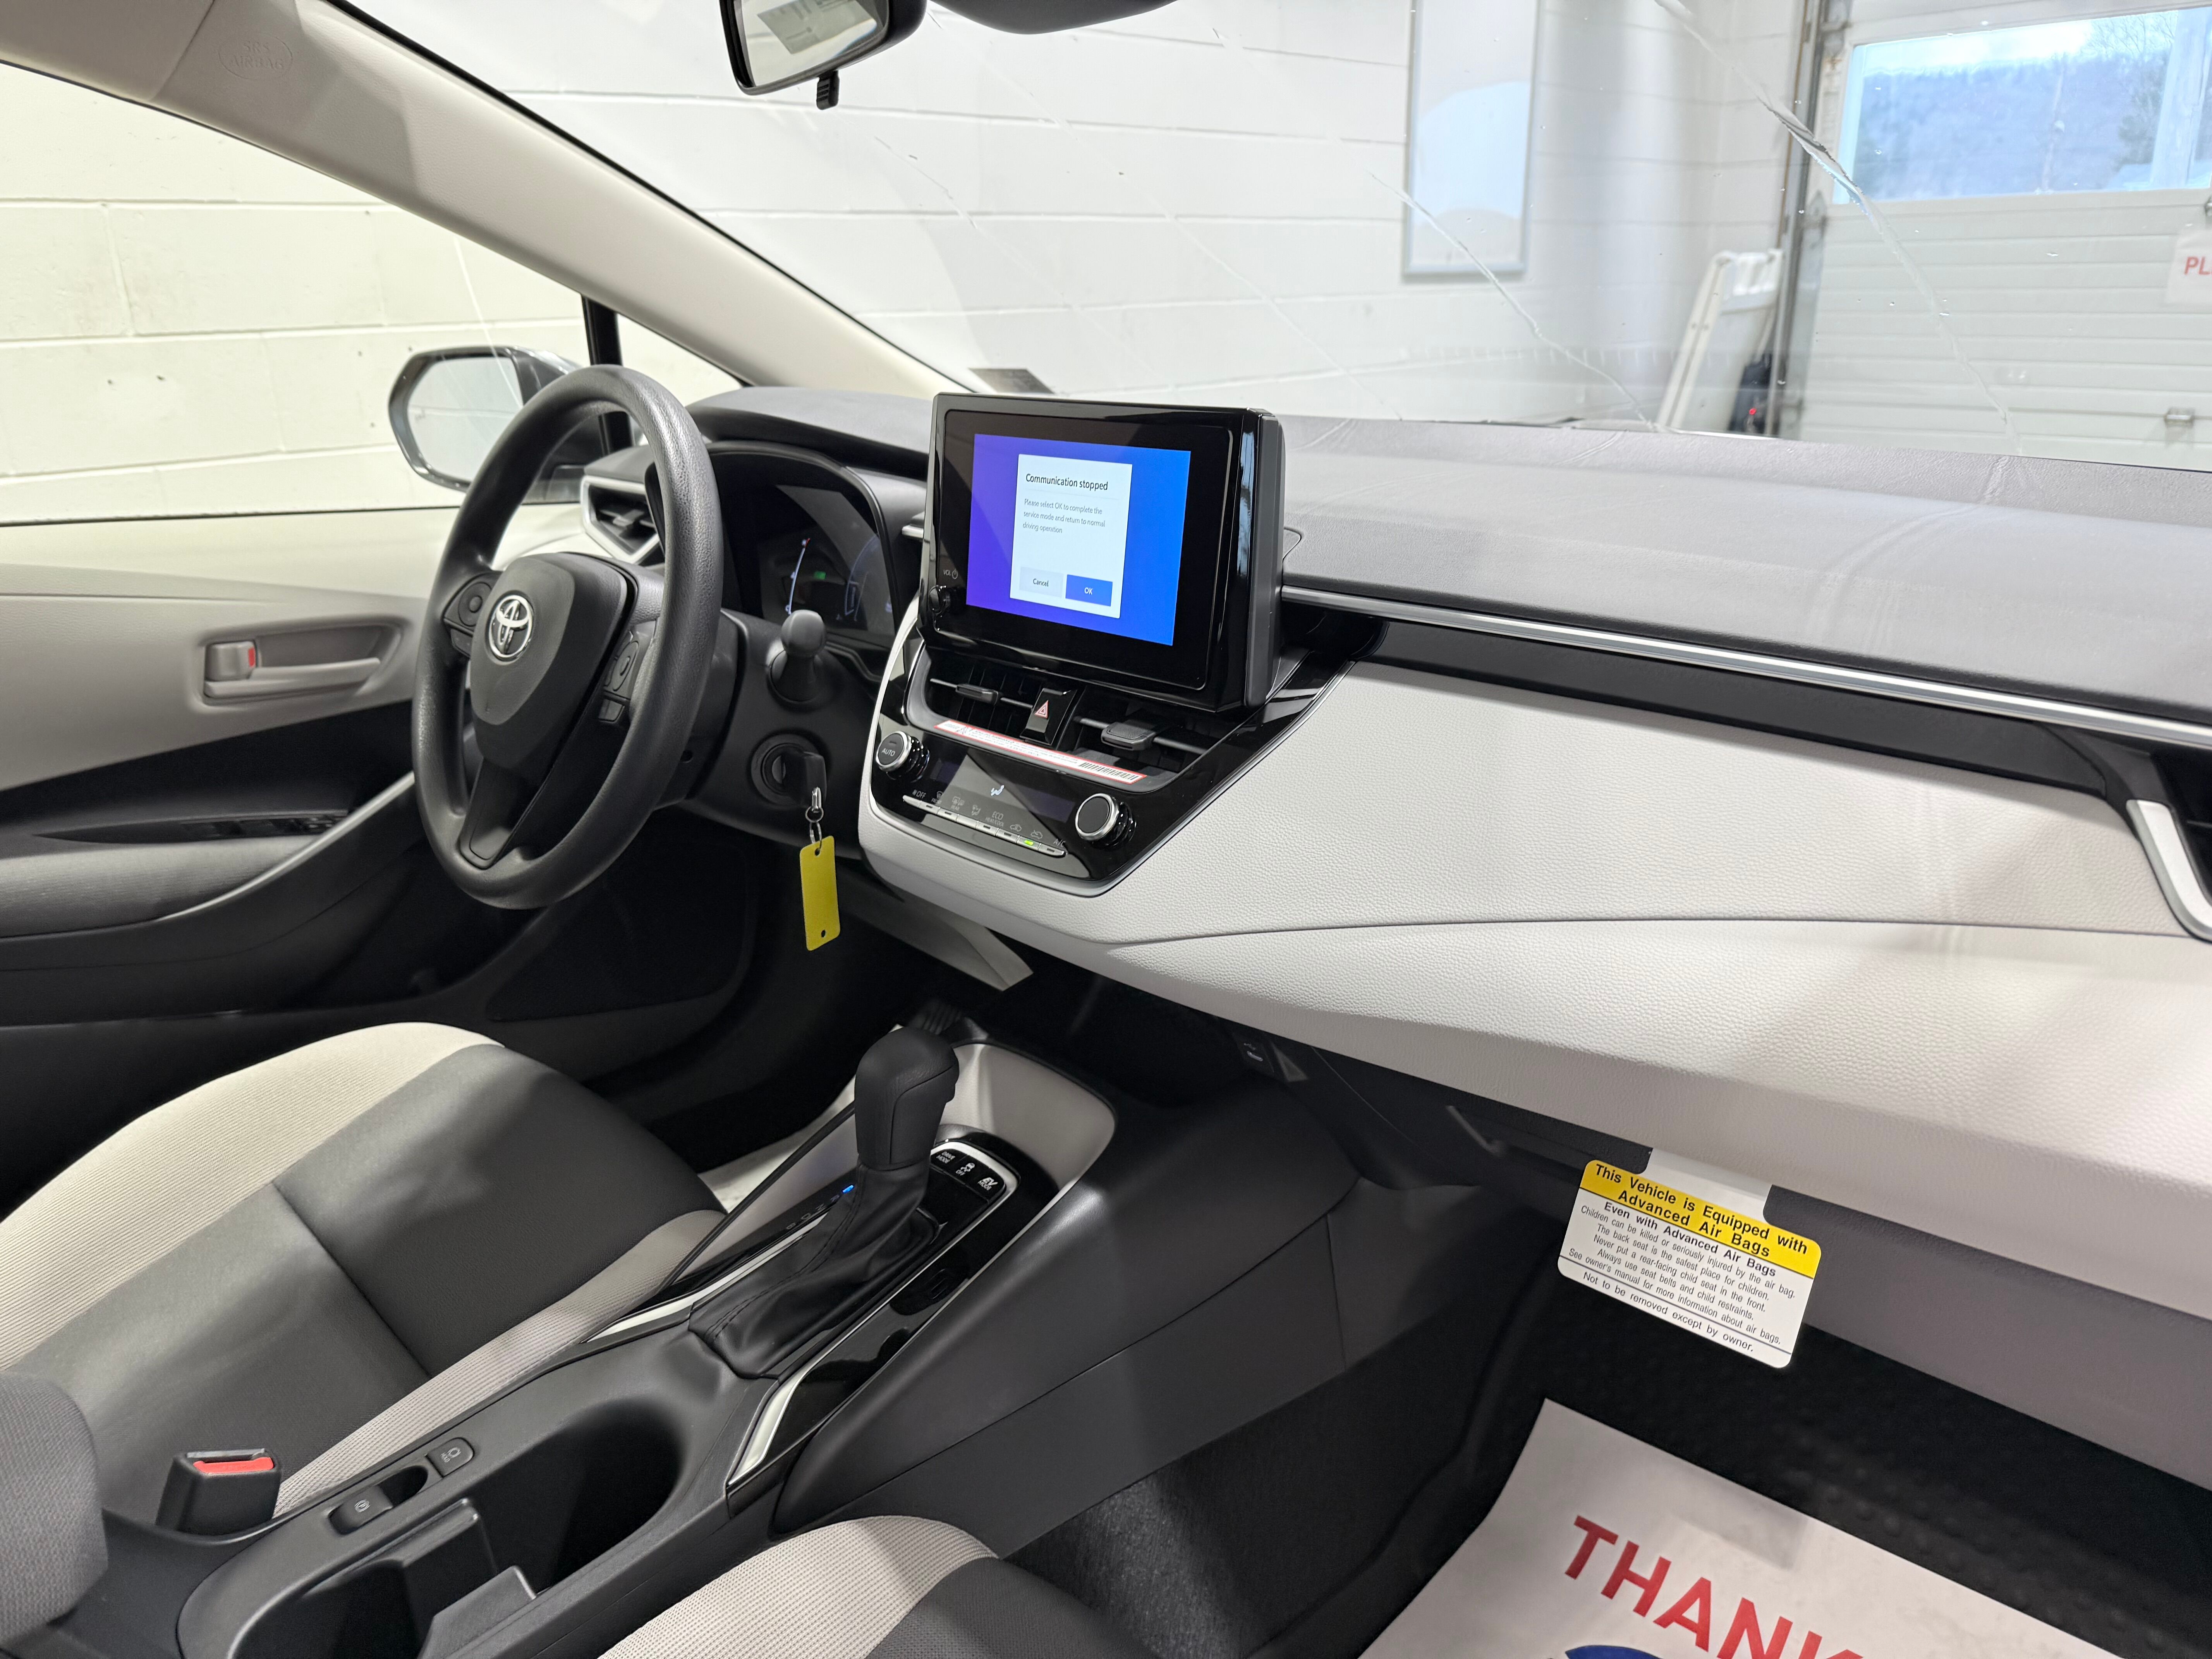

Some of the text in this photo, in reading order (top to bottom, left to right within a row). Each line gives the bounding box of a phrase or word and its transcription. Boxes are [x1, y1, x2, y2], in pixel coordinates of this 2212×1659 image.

[2184, 256, 2212, 275] PL
[1026, 473, 1108, 491] Communication stopped
[1023, 522, 1039, 531] driving
[1033, 578, 1049, 587] Cancel
[881, 748, 895, 757] AUTO
[992, 811, 1004, 820] ECO
[1053, 838, 1065, 848] A/C
[981, 1177, 998, 1186] EV
[1596, 1164, 1807, 1254] This Vehicle is Equipped with
[1581, 1205, 1608, 1223] Children
[1611, 1219, 1624, 1229] can
[1627, 1223, 1637, 1234] be
[1640, 1228, 1659, 1243] killed
[1672, 1243, 1704, 1262] seriously
[1707, 1255, 1733, 1273] injured
[1736, 1267, 1745, 1279] by
[1749, 1273, 1761, 1284] the
[1765, 1280, 1776, 1289] air
[1779, 1284, 1795, 1299] bag.
[1604, 1201, 1776, 1276] Even with Advanced Air Bags
[1618, 1190, 1769, 1257] Advanced Air Bags
[1594, 1234, 1614, 1249] Never
[1616, 1245, 1628, 1255] put
[1639, 1255, 1677, 1277] rear-facing
[1680, 1271, 1698, 1283] child
[1700, 1280, 1717, 1292] seat
[1720, 1286, 1727, 1296] in
[1731, 1291, 1743, 1302] the
[1747, 1297, 1765, 1312] front.
[1597, 1248, 1753, 1320] Always use seat belts and child restraints.
[1598, 1223, 1769, 1300] The back seat is the safest place for children.
[1569, 1248, 1780, 1345] See owner's manual for more information about air bags.
[1583, 1271, 1753, 1352] Not to be removed except by owner.
